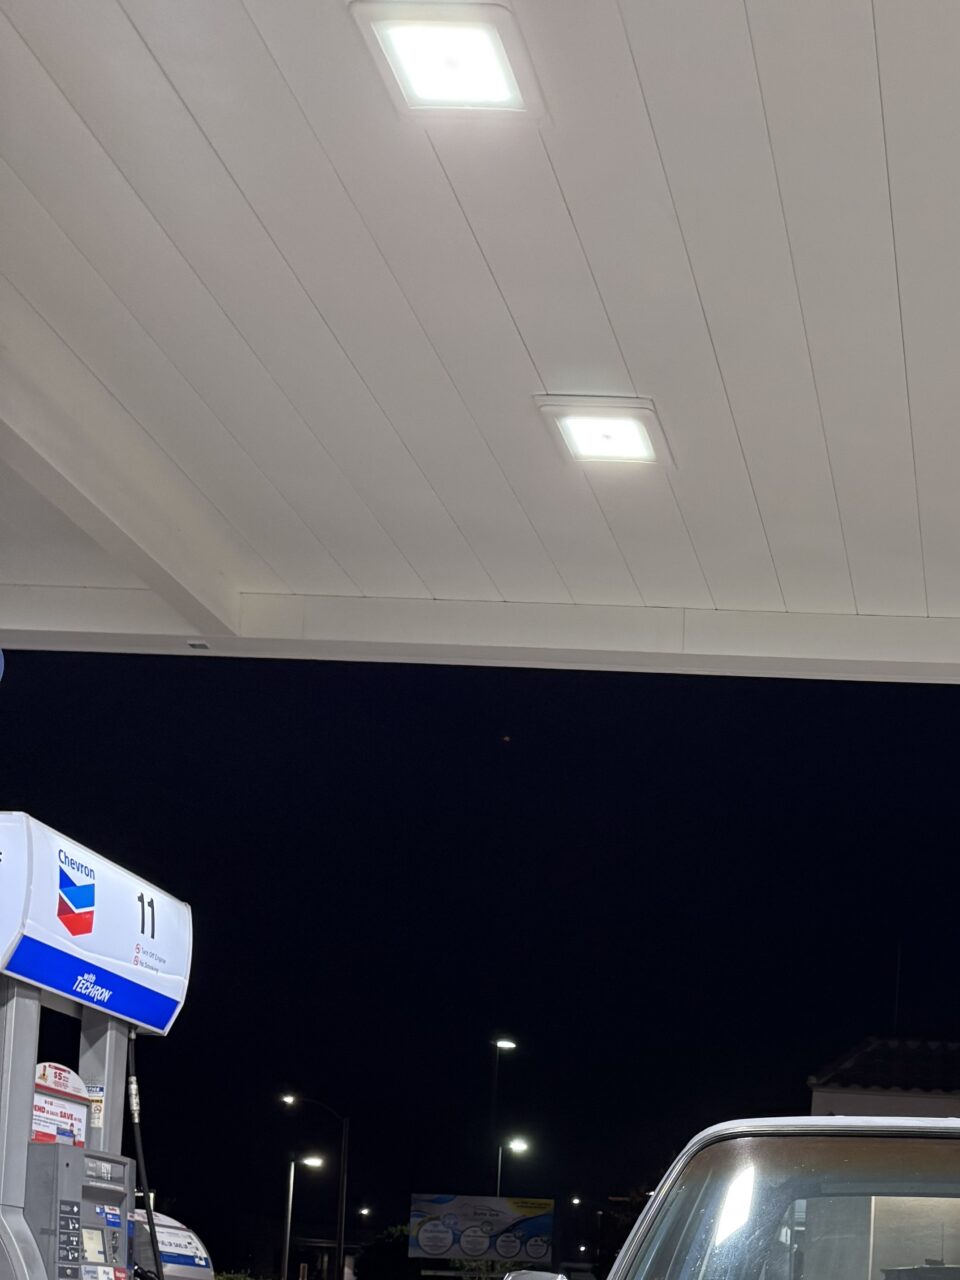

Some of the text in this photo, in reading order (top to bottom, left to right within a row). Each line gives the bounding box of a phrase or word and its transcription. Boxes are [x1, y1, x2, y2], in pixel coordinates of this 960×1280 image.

[58, 849, 95, 880] Chevron
[137, 892, 155, 940] 11
[72, 976, 112, 1002] TECHRON
[83, 972, 96, 982] with
